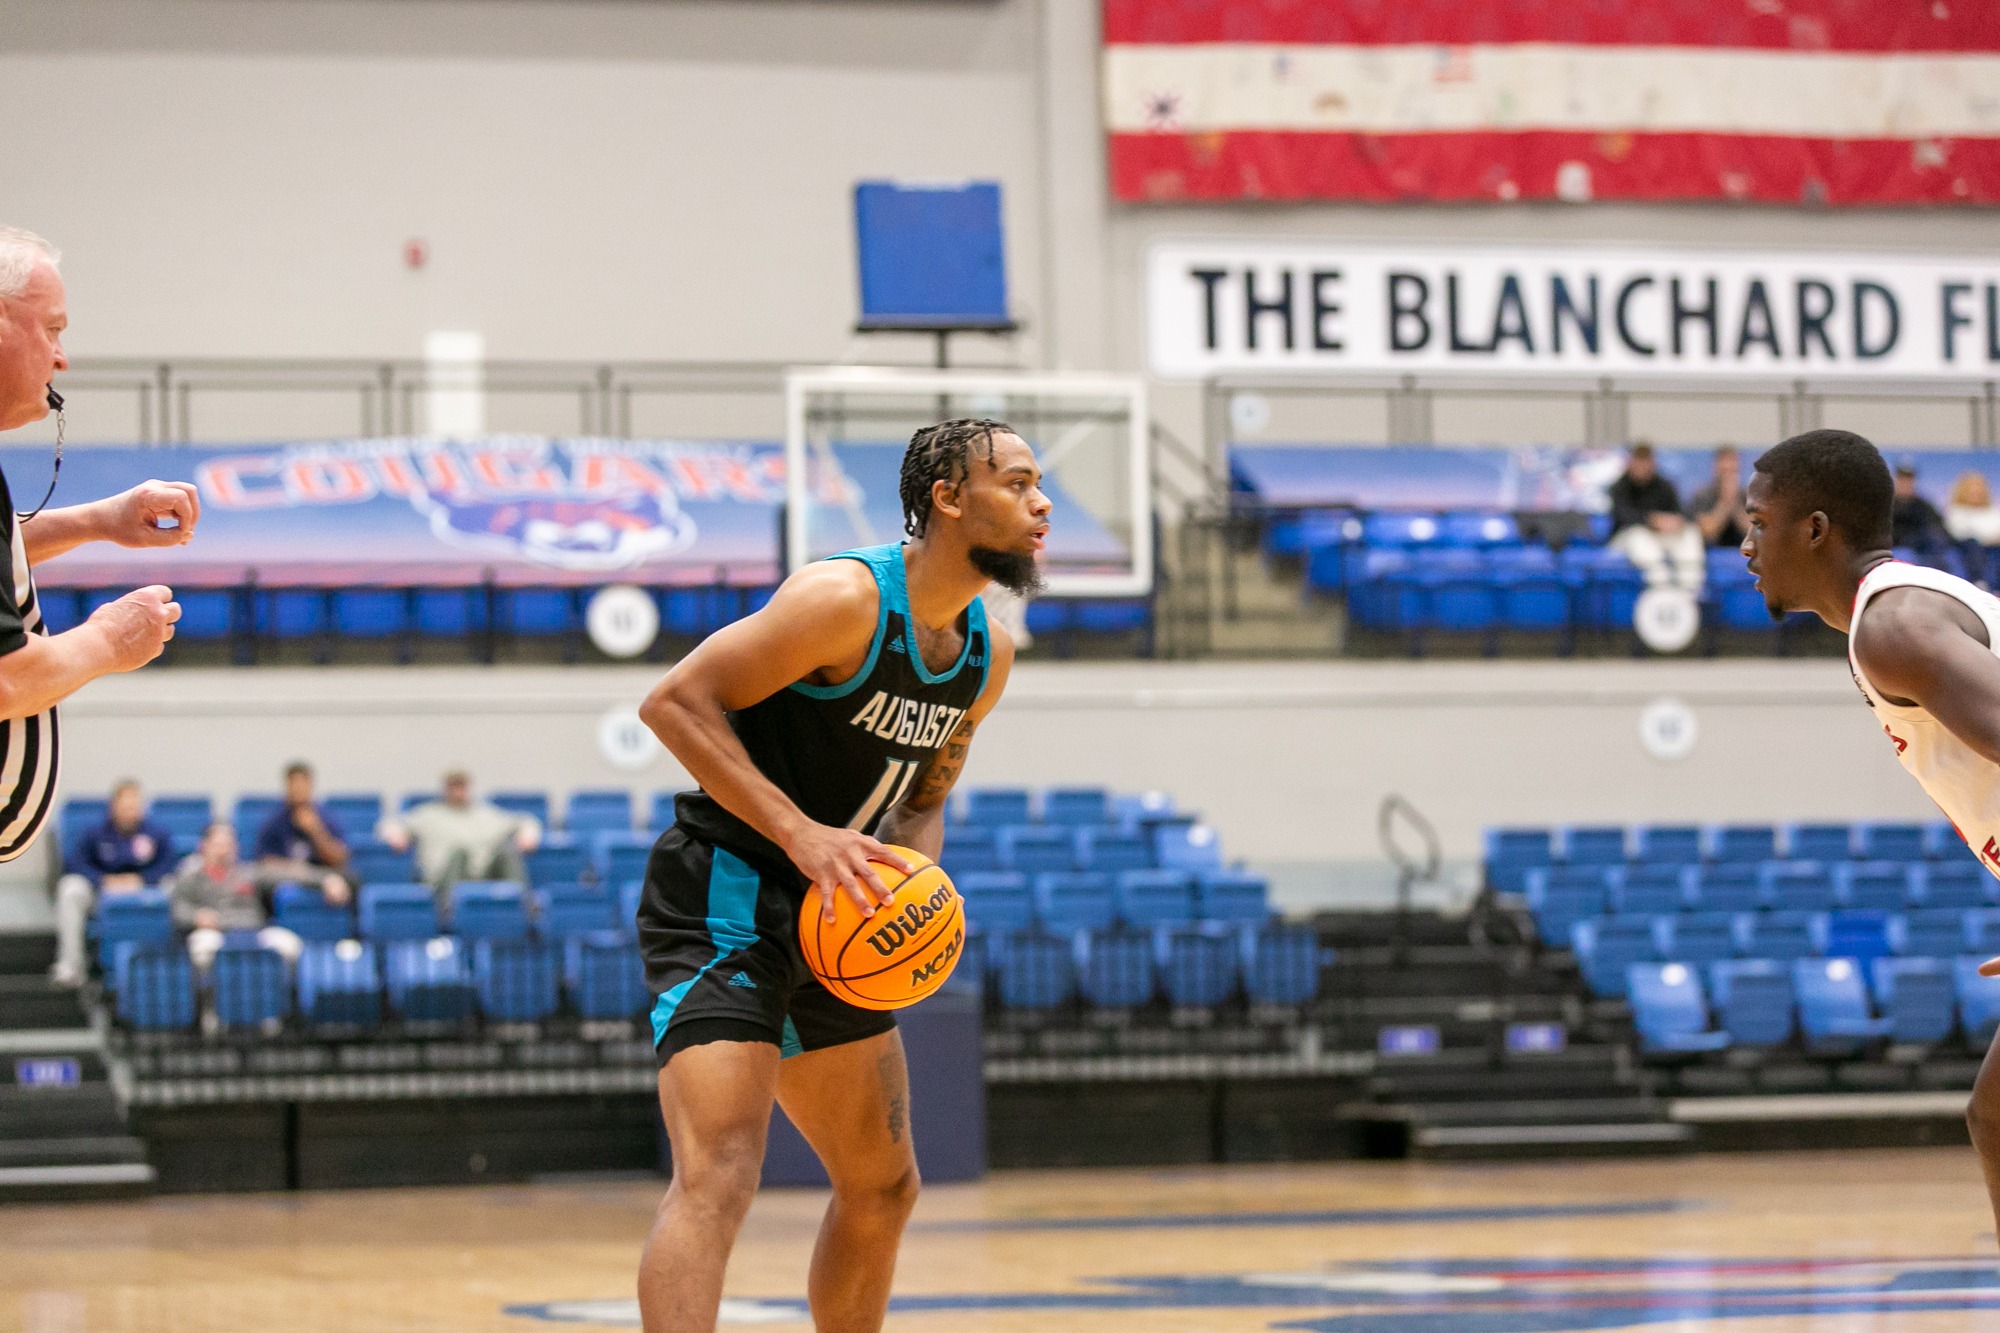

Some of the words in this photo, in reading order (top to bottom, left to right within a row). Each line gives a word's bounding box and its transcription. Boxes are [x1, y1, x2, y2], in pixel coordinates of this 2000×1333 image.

[1189, 267, 1345, 353] THE
[1386, 270, 1902, 359] BLANCHARD
[866, 883, 953, 957] Wilson
[911, 927, 962, 987] NCAA
